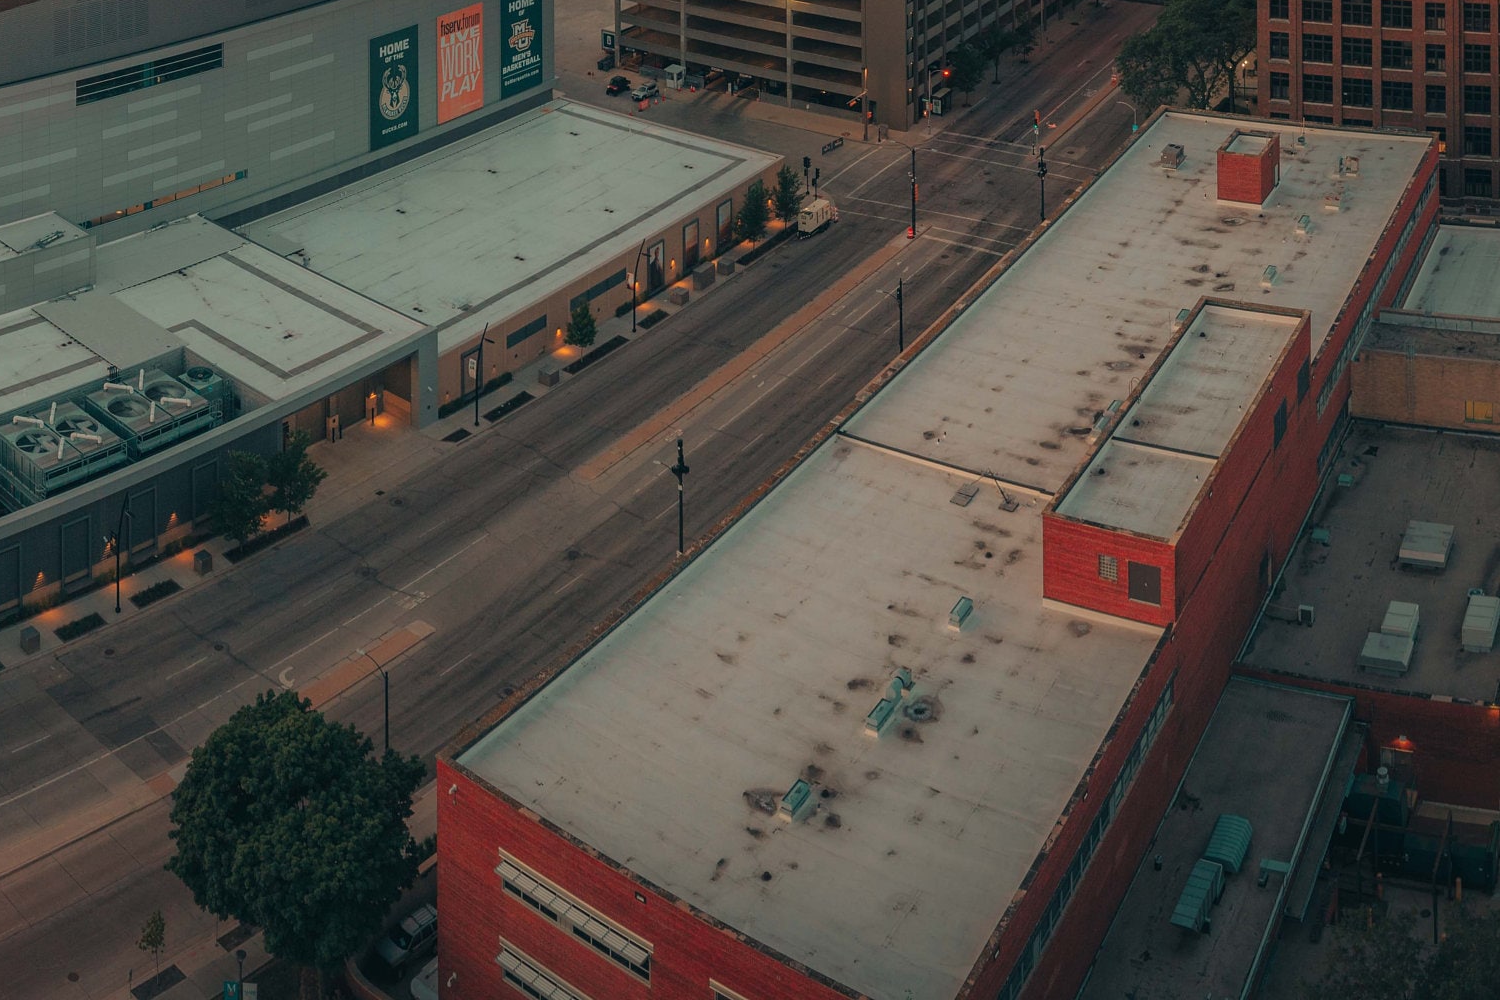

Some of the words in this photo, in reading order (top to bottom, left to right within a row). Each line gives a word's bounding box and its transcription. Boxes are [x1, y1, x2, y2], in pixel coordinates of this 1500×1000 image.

[440, 13, 480, 37] fiserv.forum
[440, 25, 480, 48] LIVE
[380, 38, 410, 58] HOME
[385, 55, 393, 63] OF
[393, 52, 404, 61] THE
[440, 36, 481, 81] WORK
[512, 50, 532, 63] MEN'S
[502, 54, 541, 75] BASKETBALL
[441, 70, 481, 103] PLAY
